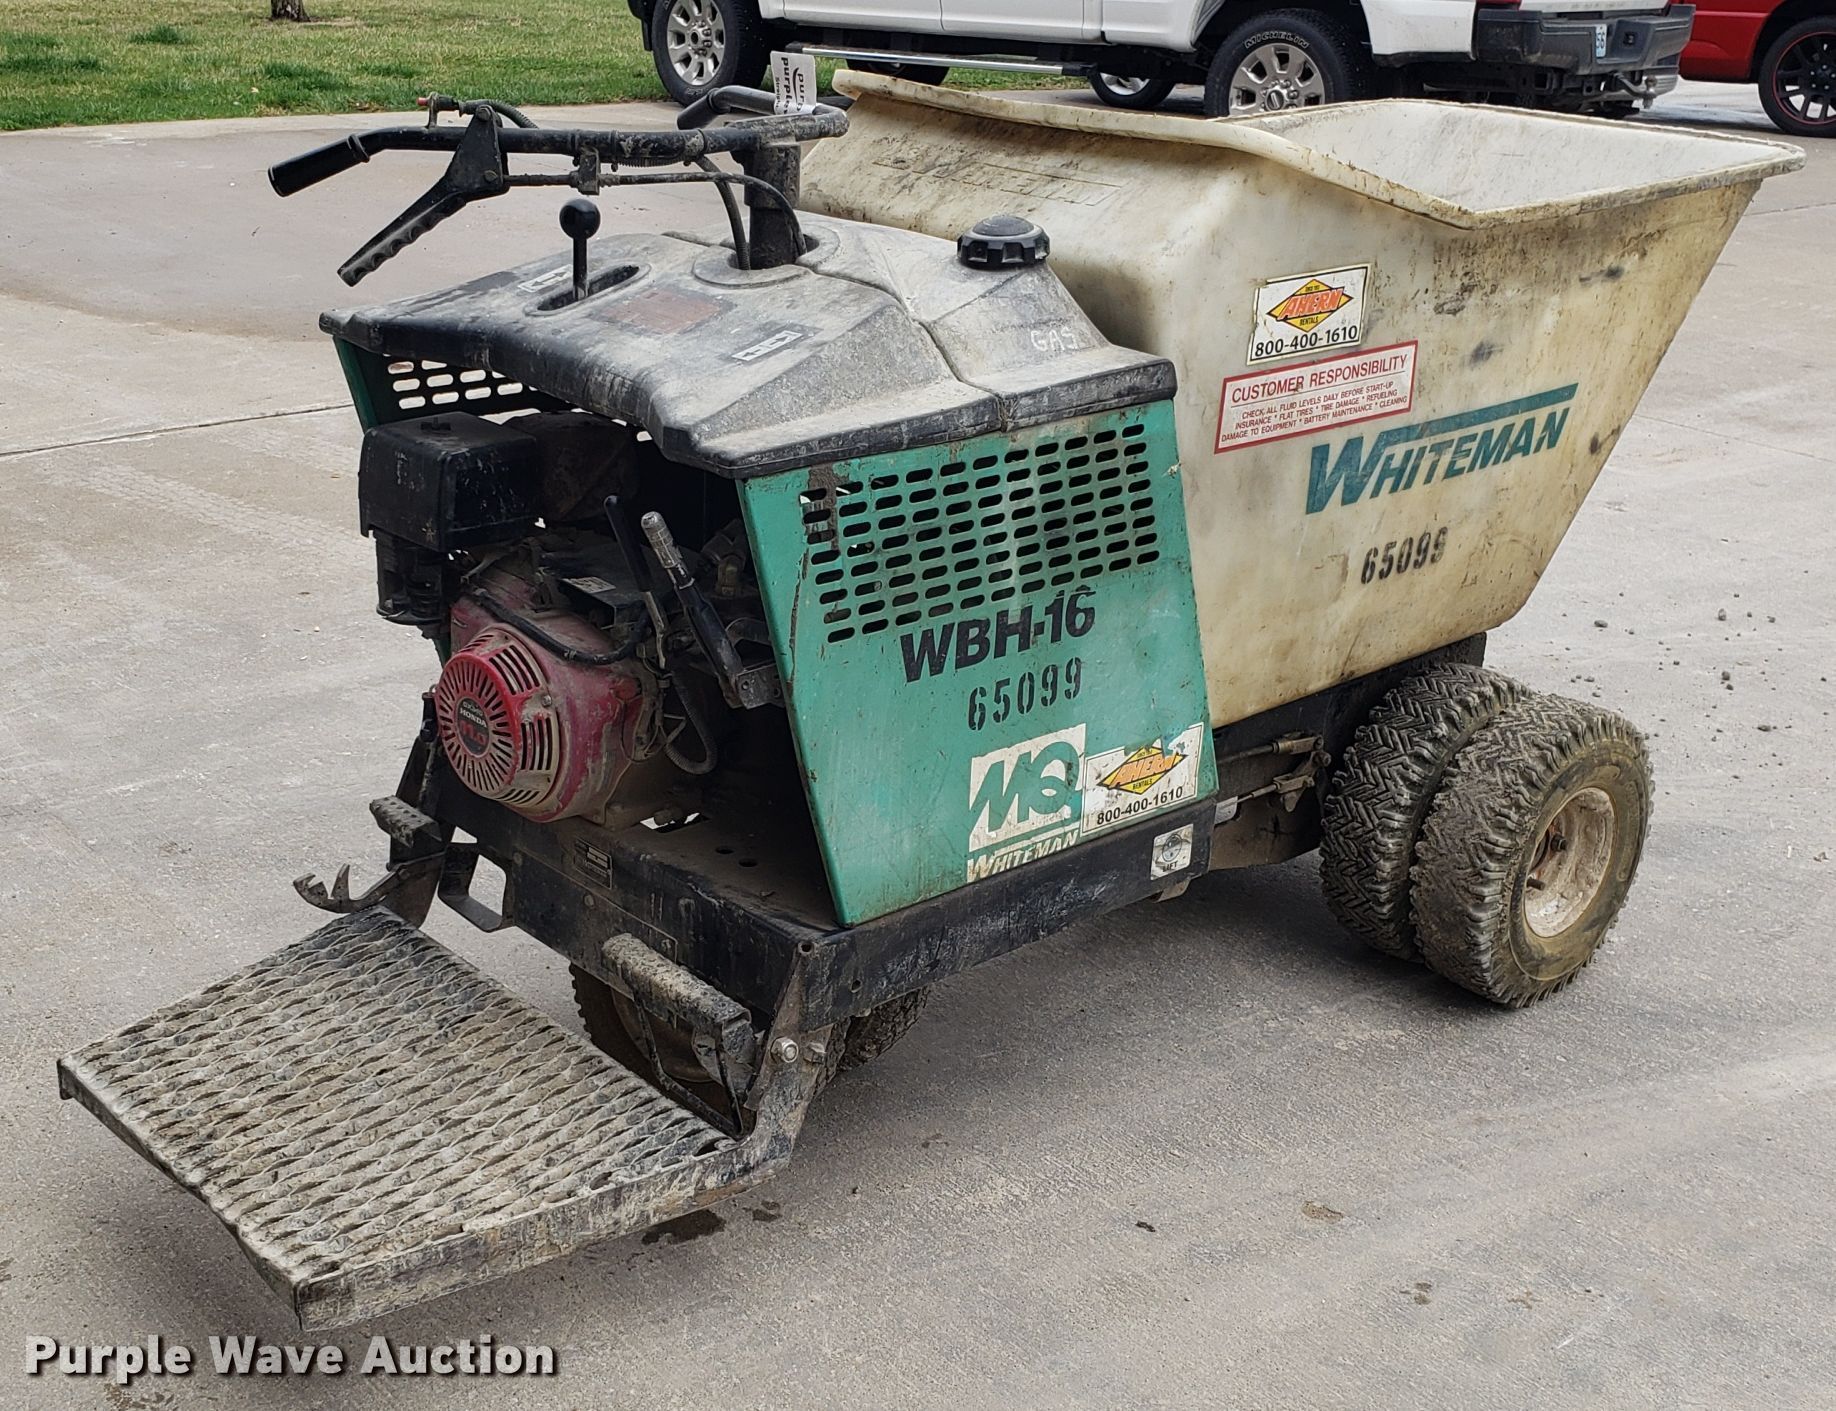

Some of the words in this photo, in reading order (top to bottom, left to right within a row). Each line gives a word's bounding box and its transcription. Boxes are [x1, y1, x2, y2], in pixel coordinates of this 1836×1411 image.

[1244, 31, 1310, 49] MICHELIN
[1278, 289, 1342, 320] AHERN
[1300, 316, 1319, 326] RENTALS
[1030, 326, 1078, 352] GAS
[1254, 325, 1358, 358] 800-400-1610
[1232, 376, 1305, 404] CUSTOMER
[1309, 354, 1408, 389] RESPONSIBILITY
[1267, 406, 1278, 414] ALL
[1280, 402, 1297, 412] FLUID
[1299, 397, 1322, 408] LEVELS
[1323, 393, 1339, 403] DAILY
[1341, 388, 1364, 399] BEFORE
[1366, 382, 1394, 394] START-UP
[1221, 430, 1249, 442] DAMAGE
[1250, 428, 1259, 436] TO
[1261, 420, 1297, 434] EQUIPMENT
[1304, 413, 1331, 425] BATTERY
[1332, 404, 1373, 418] MAINTENANCE
[1379, 396, 1408, 408] CLEANING
[1235, 416, 1272, 430] INSURANCE
[1279, 411, 1294, 421] FLAT
[1296, 407, 1314, 417] TIRES
[1321, 402, 1334, 412] TIRE
[1335, 398, 1360, 409] DAMAGE
[1367, 389, 1398, 402] REFUELING
[1306, 383, 1578, 515] WHITEMAN
[1361, 526, 1448, 584] 65099
[899, 585, 1097, 683] WBH-16
[968, 657, 1082, 731] 65099
[460, 707, 488, 728] HONDA
[1132, 779, 1153, 790] RENTALS
[1097, 786, 1183, 825] 800-400-1610
[967, 824, 1079, 883] WHITEMAN
